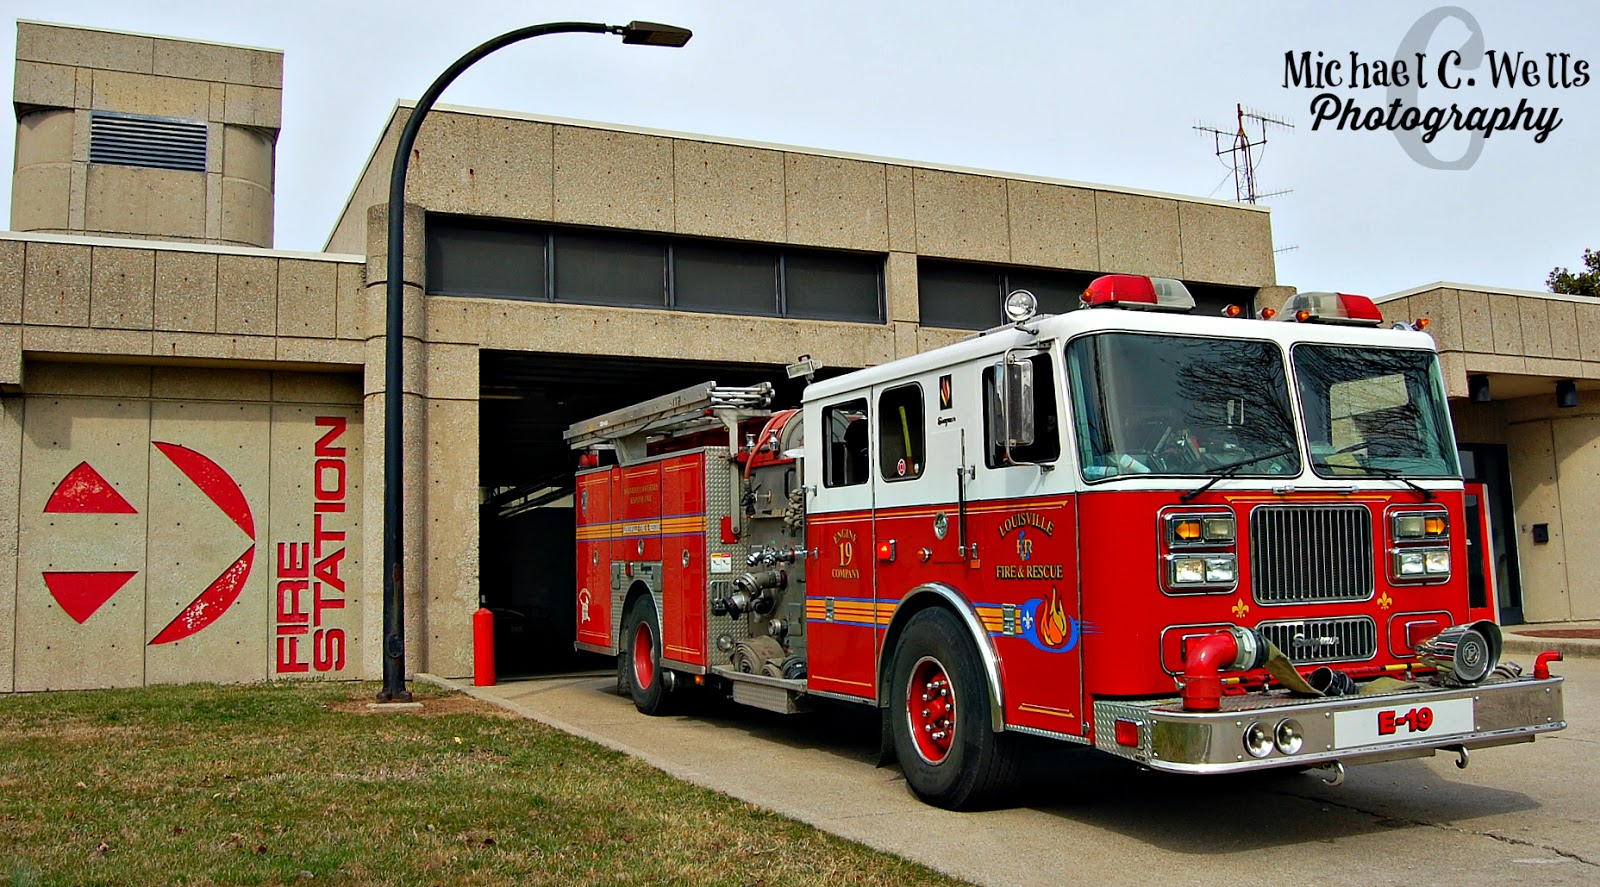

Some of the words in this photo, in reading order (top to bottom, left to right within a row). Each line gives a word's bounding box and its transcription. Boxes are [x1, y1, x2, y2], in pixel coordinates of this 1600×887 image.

[833, 528, 858, 544] ENGINE
[998, 512, 1055, 537] LOUISVILLE
[313, 416, 347, 672] STATION
[839, 542, 853, 567] 19
[832, 568, 860, 579] COMPANY
[996, 565, 1017, 579] FIRE
[1018, 565, 1025, 579] &
[1026, 564, 1064, 579] RESCUE
[276, 542, 310, 674] FIRE
[1378, 706, 1434, 736] E-19
